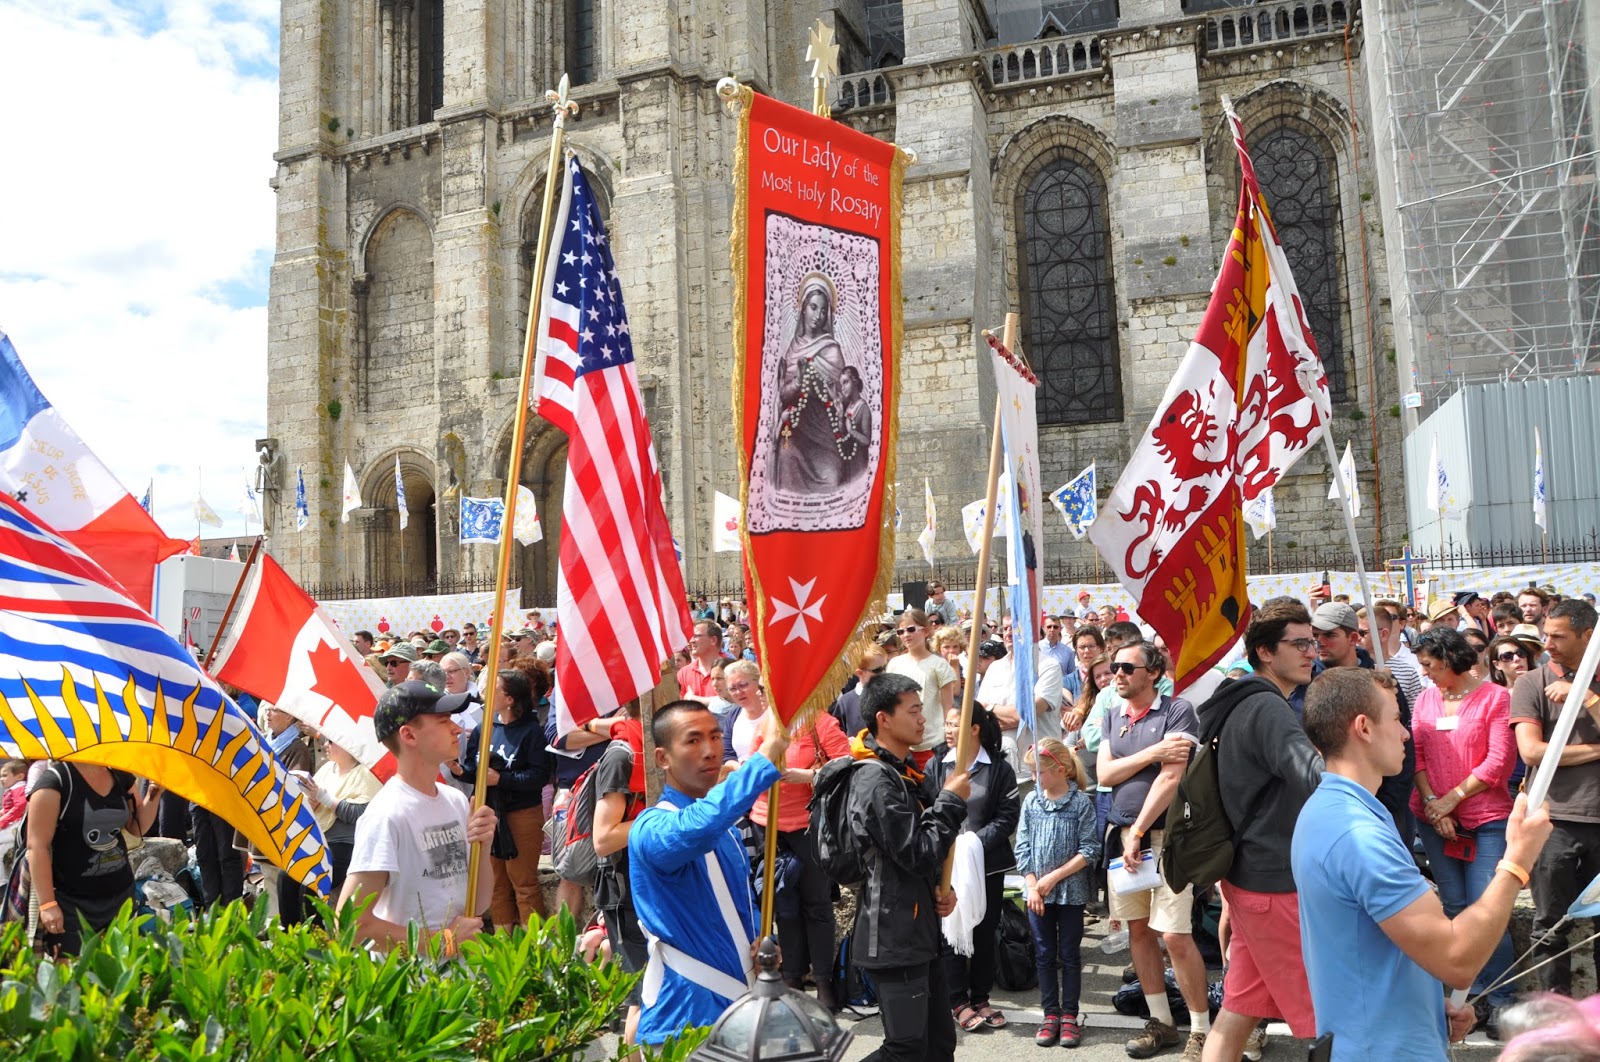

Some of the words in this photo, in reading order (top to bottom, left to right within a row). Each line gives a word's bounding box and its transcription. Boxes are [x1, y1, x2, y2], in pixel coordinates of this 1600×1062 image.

[763, 127, 799, 156] Our
[803, 139, 841, 178] Lady
[844, 158, 859, 178] of
[863, 164, 879, 186] the
[761, 171, 793, 194] Most
[797, 181, 825, 209] Holy
[830, 188, 882, 229] Rosary
[419, 826, 464, 852] BATTLESH
